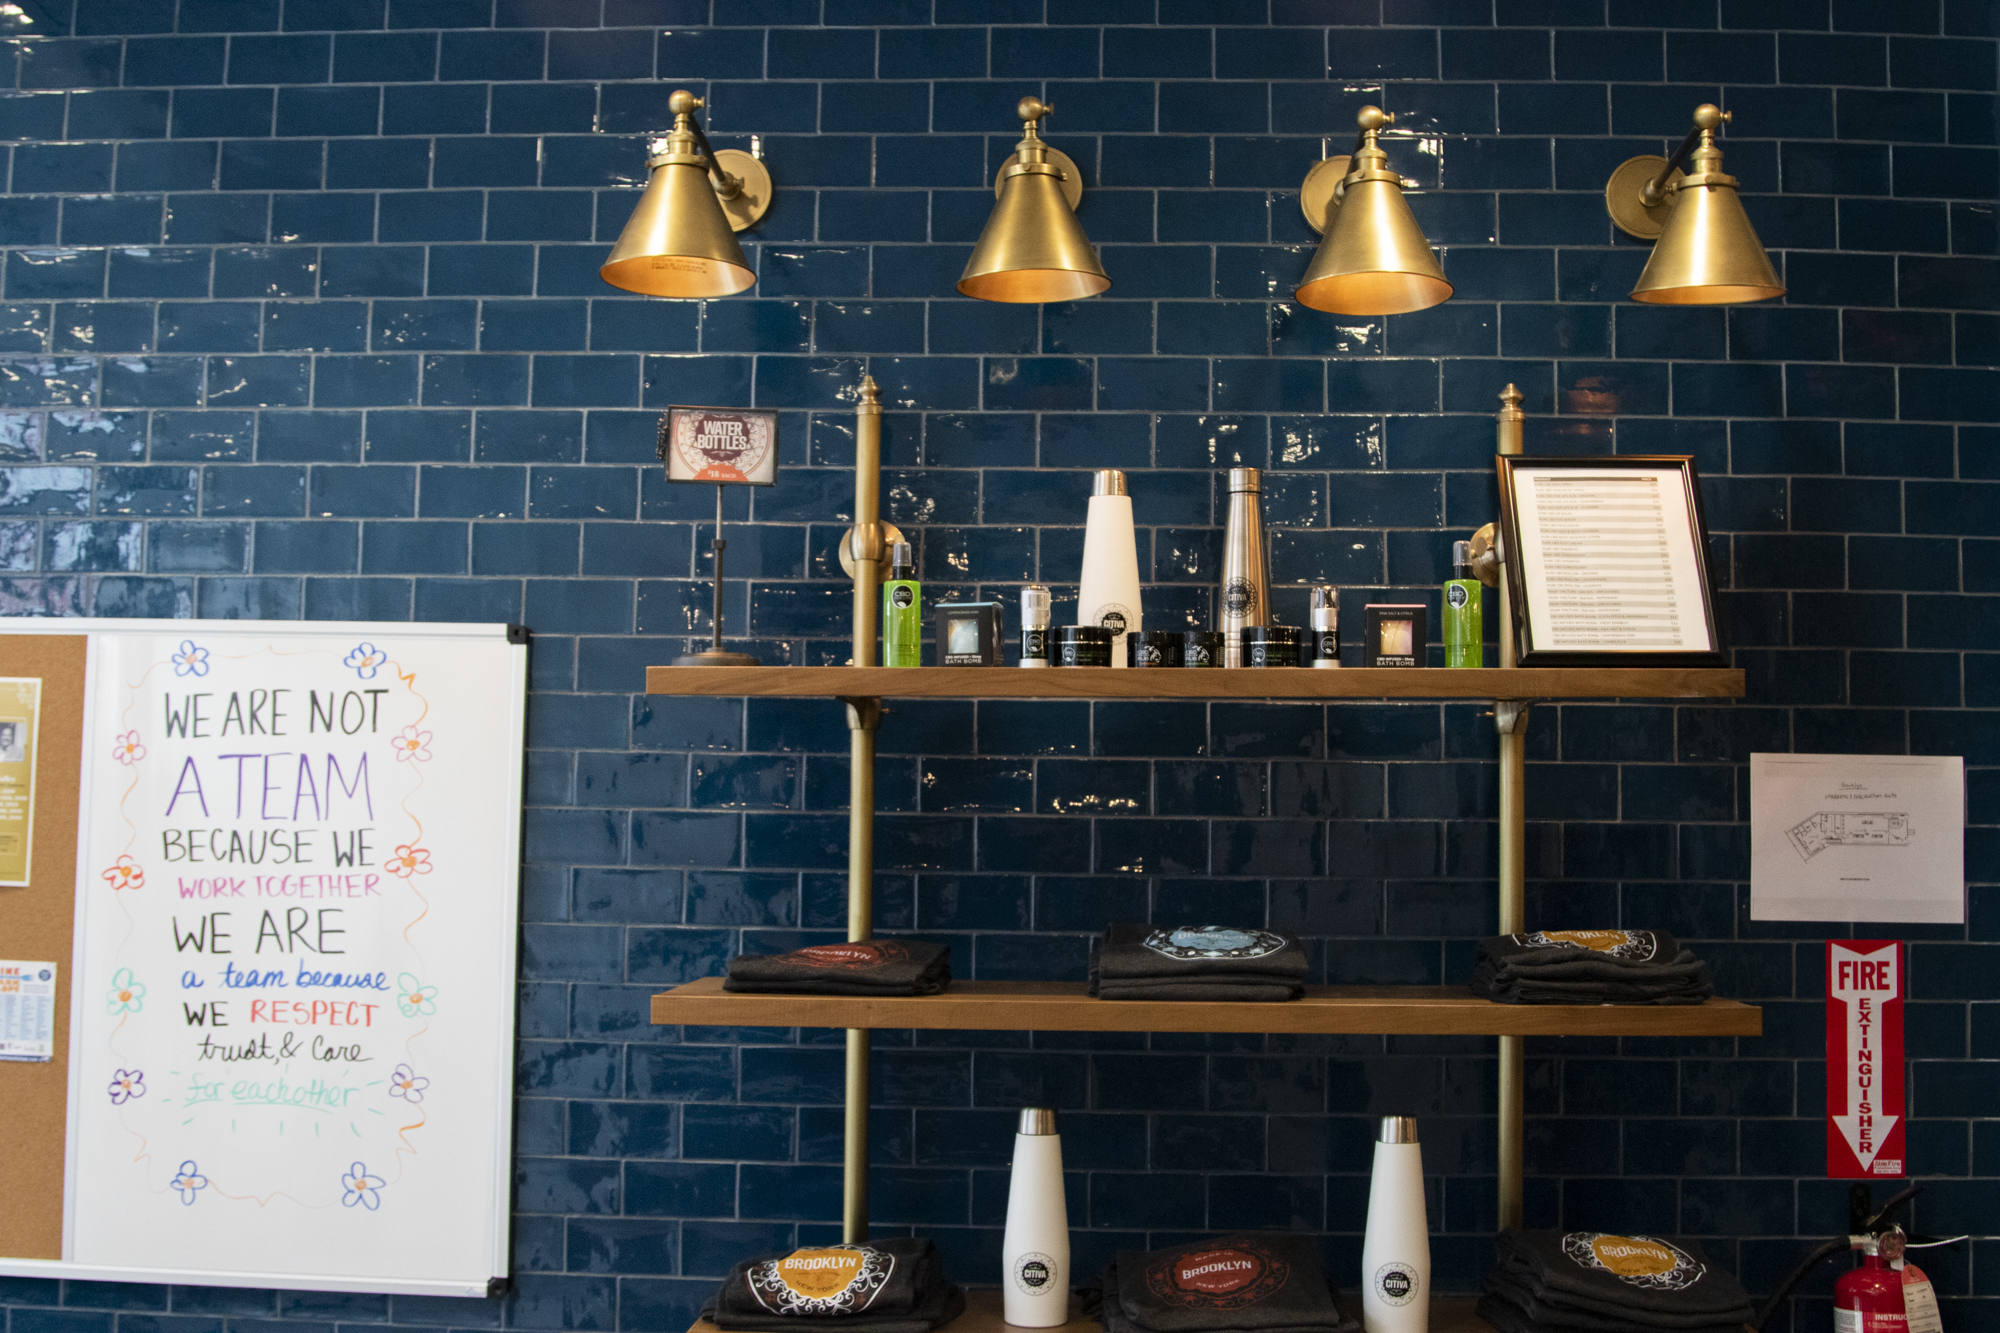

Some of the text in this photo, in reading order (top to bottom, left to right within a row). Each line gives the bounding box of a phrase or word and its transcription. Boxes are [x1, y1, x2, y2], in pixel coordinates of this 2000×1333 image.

[703, 421, 743, 436] WATER
[697, 434, 748, 450] BOTTLES
[707, 470, 720, 478] $18
[1103, 620, 1124, 629] CITIVA
[164, 688, 390, 739] WE ARE NOT
[164, 751, 375, 822] A TEAM
[162, 828, 376, 868] BECAUSE WE
[177, 873, 382, 900] WORK TOGETHER
[172, 907, 347, 955] WE ARE
[181, 958, 392, 991] a team because
[1838, 960, 1890, 990] FIRE
[184, 999, 381, 1028] WE RESPECT
[1858, 997, 1872, 1154] EXTINGUISHER
[184, 1072, 226, 1102] for
[785, 1256, 856, 1270] BROOKLYN
[1600, 1246, 1668, 1260] BROOKLYN
[1024, 1270, 1046, 1278] CITIVA
[1182, 1260, 1252, 1280] BROOKLYN
[795, 1280, 840, 1293] NEW YORK
[1218, 1279, 1240, 1288] YORK
[1386, 1280, 1408, 1289] CITIVA
